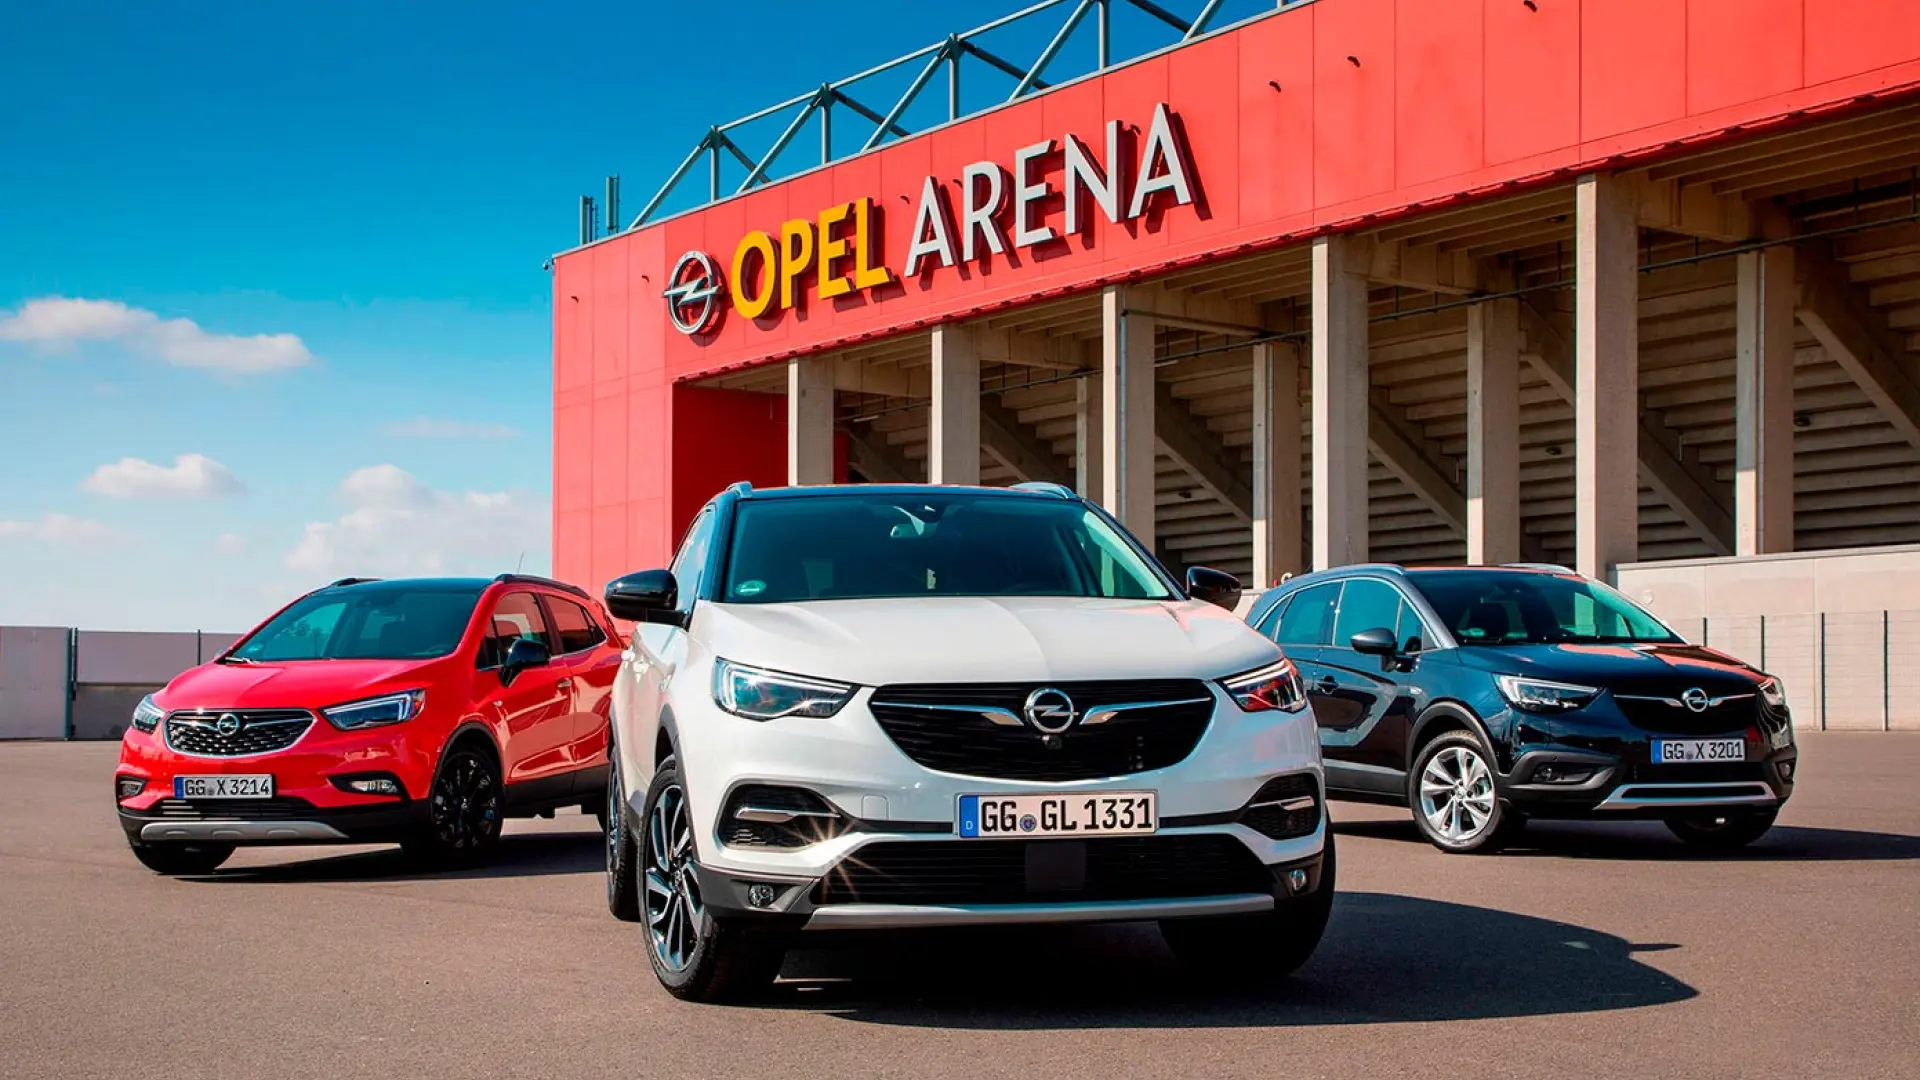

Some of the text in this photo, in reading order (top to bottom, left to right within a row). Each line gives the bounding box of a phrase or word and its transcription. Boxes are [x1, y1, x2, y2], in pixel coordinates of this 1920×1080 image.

[730, 102, 1193, 320] OPEL ARENA
[1663, 741, 1743, 760] GG X 3201
[184, 779, 205, 796] GG
[217, 779, 226, 796] X
[230, 779, 270, 796] 3214
[981, 798, 1152, 832] GG GL 1331
